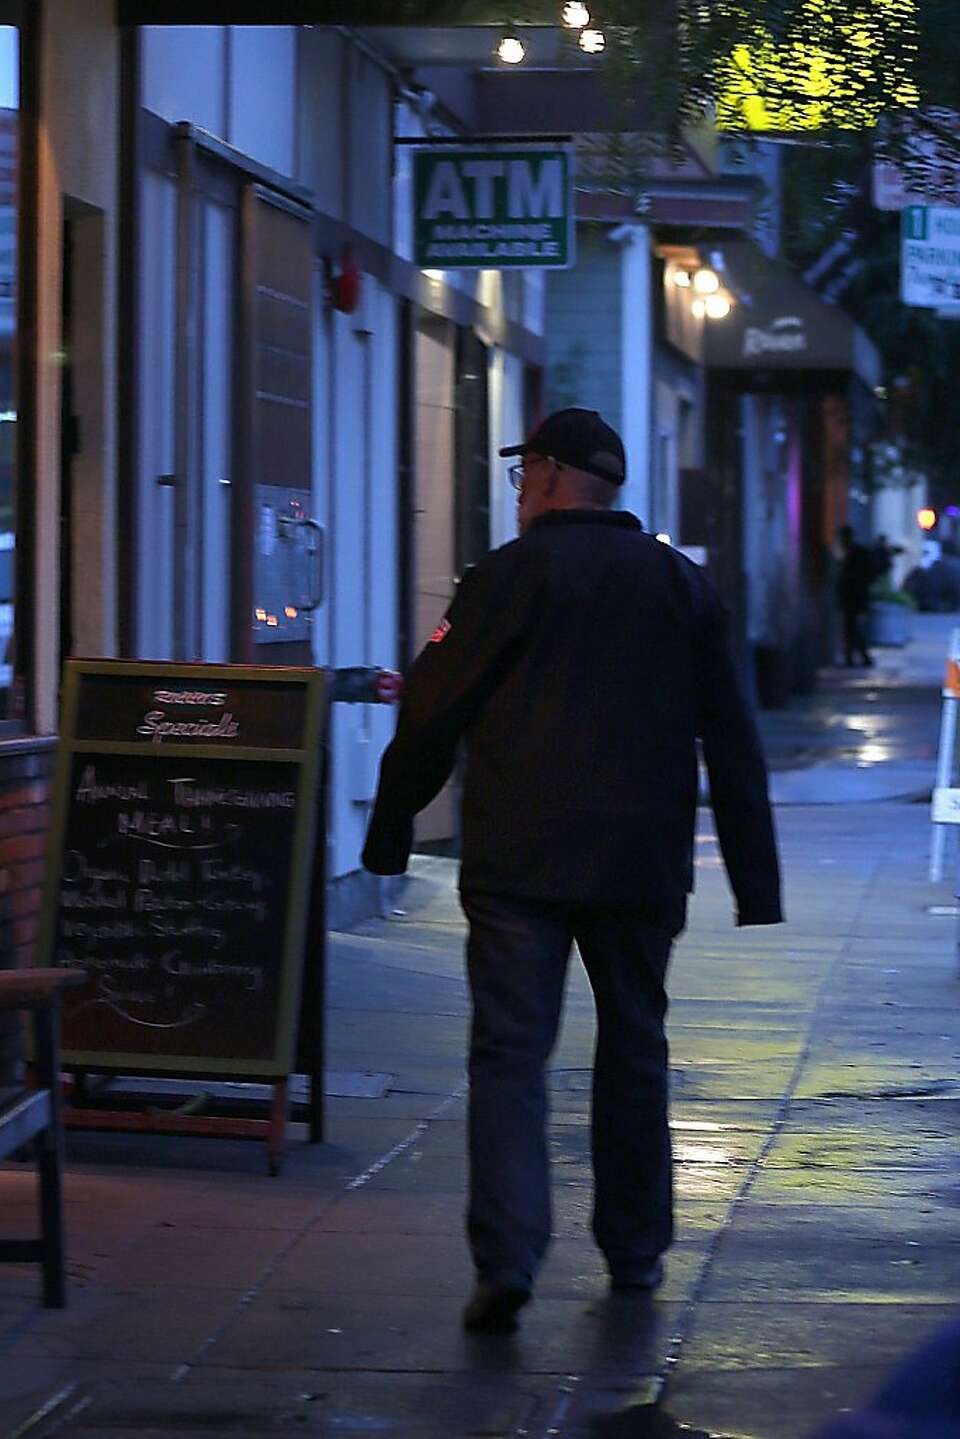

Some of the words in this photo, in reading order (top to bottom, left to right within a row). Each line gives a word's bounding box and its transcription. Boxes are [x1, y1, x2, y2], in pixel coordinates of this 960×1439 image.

[422, 160, 563, 219] ATM
[432, 224, 552, 240] MACHINE
[426, 242, 561, 258] AVAILABLE
